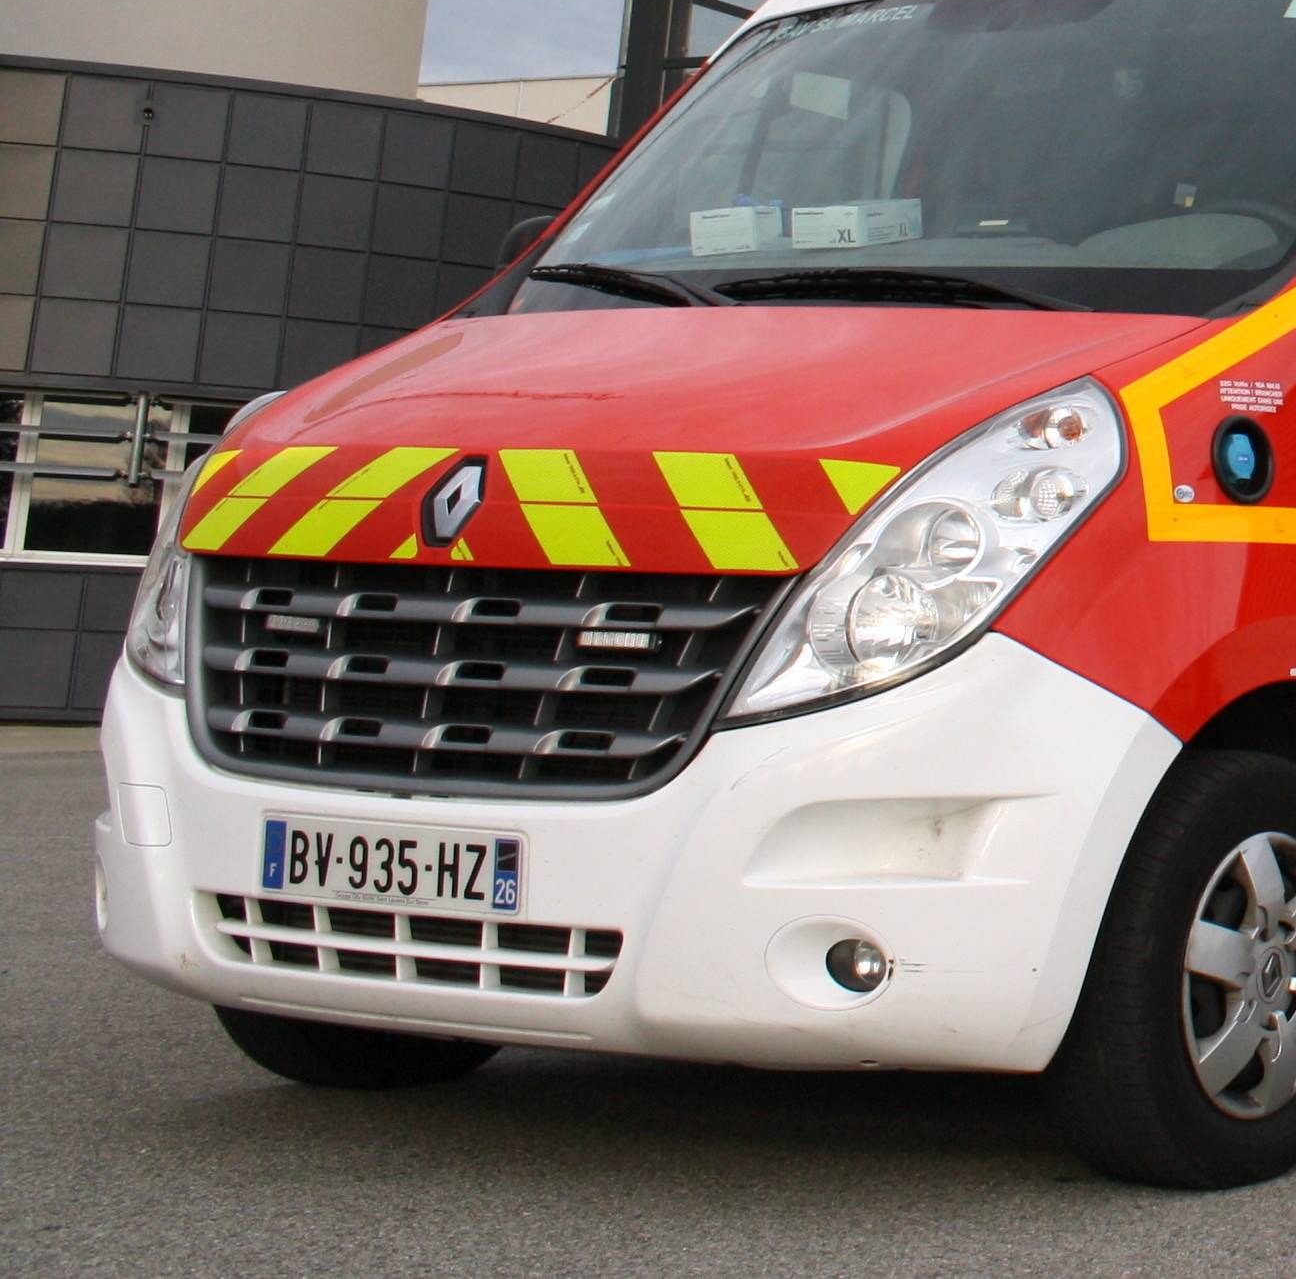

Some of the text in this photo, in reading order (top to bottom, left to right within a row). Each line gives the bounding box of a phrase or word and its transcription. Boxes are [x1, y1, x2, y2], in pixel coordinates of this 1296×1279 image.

[837, 228, 856, 243] XL
[269, 863, 278, 878] F
[289, 829, 488, 901] BV-935-HZ
[495, 878, 516, 905] 26
